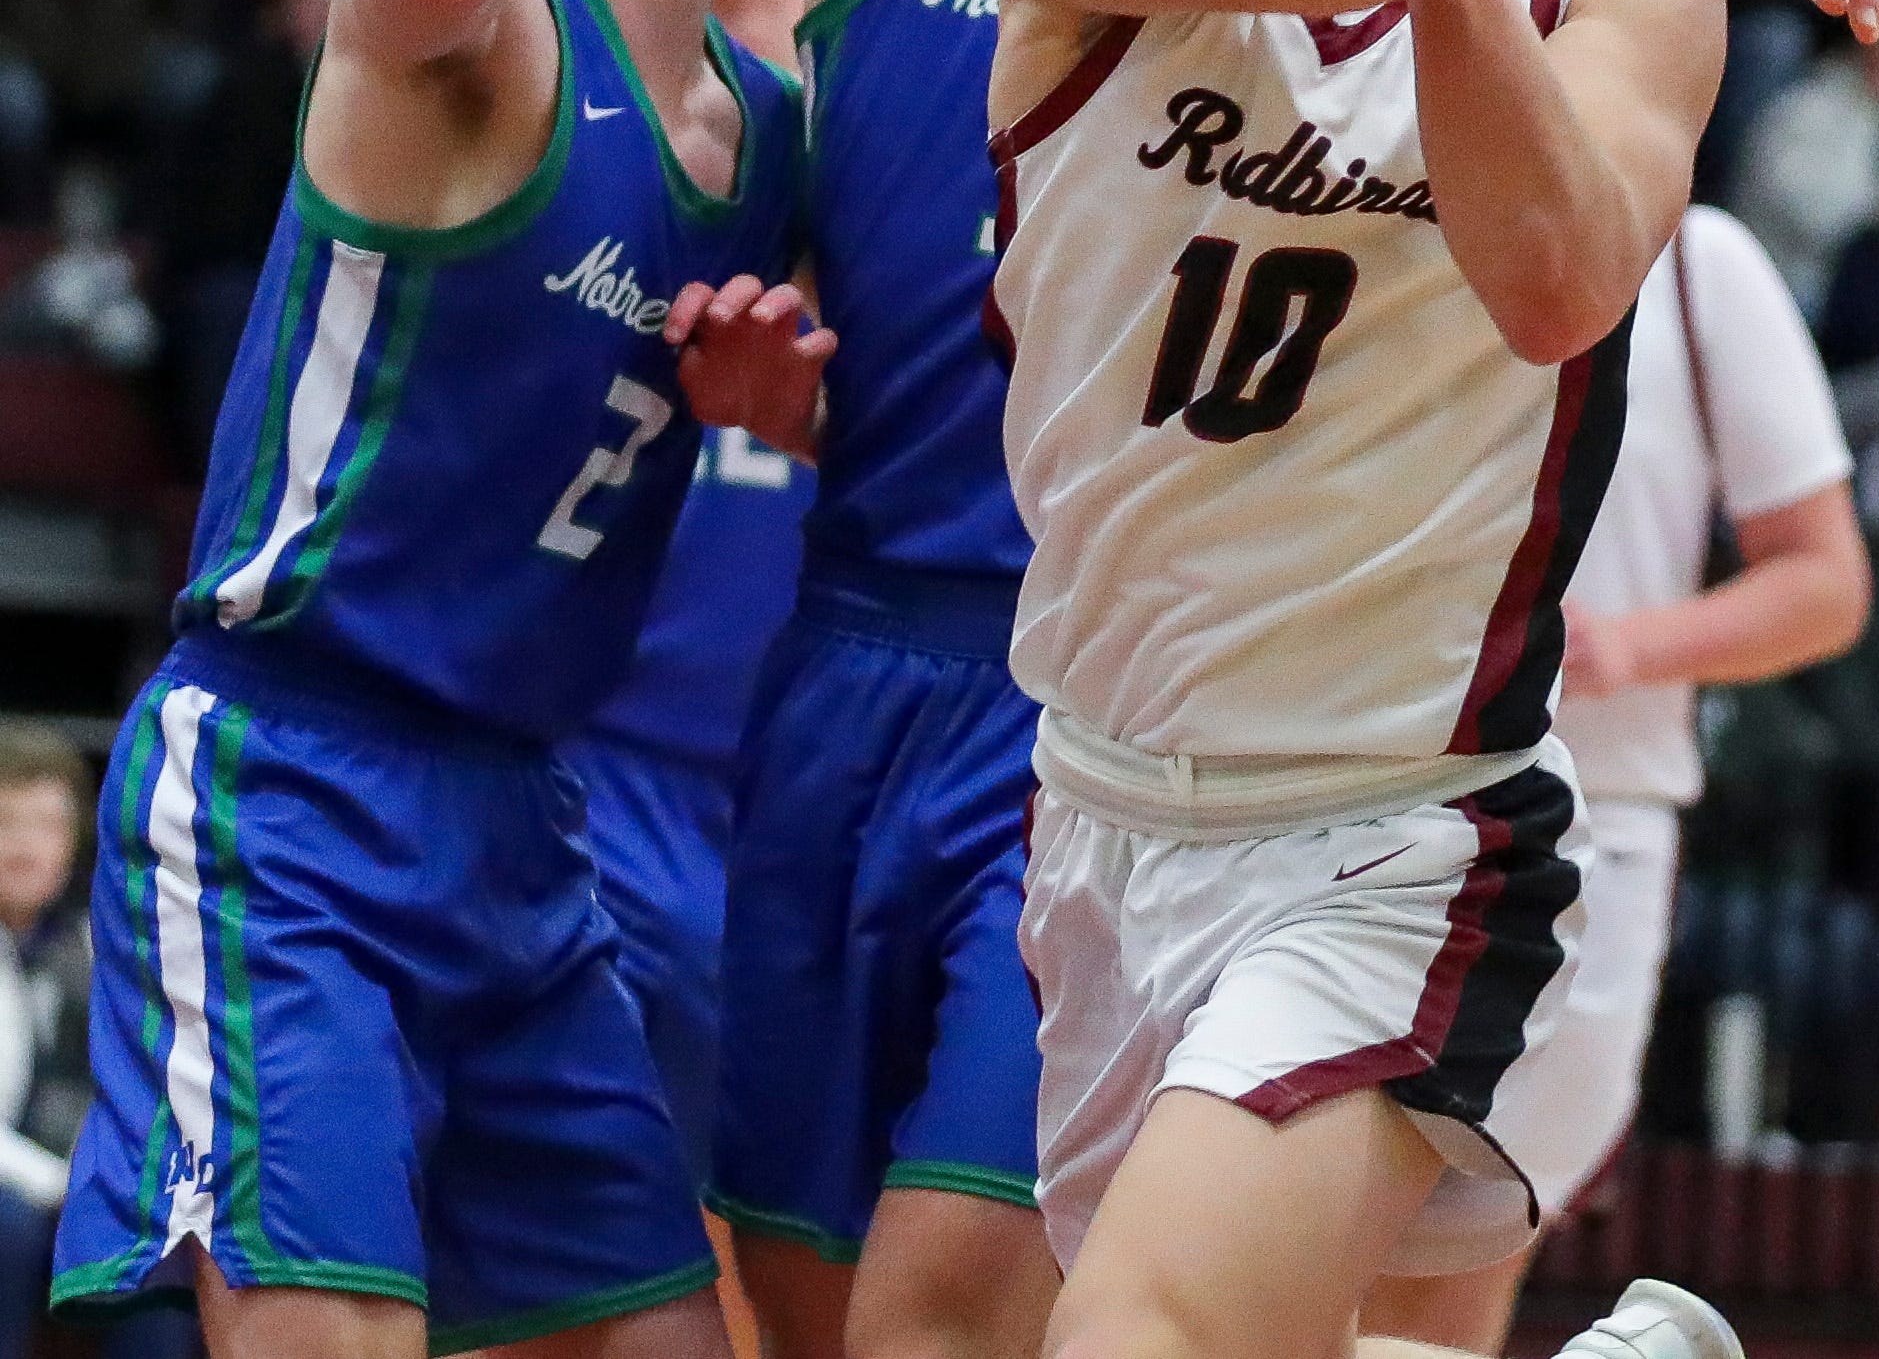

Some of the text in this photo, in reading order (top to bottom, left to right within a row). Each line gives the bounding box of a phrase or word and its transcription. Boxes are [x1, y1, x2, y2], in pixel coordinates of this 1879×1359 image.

[1137, 87, 1440, 223] Rdbir
[544, 235, 670, 333] Notre
[1140, 234, 1358, 443] 10
[540, 374, 673, 560] 2
